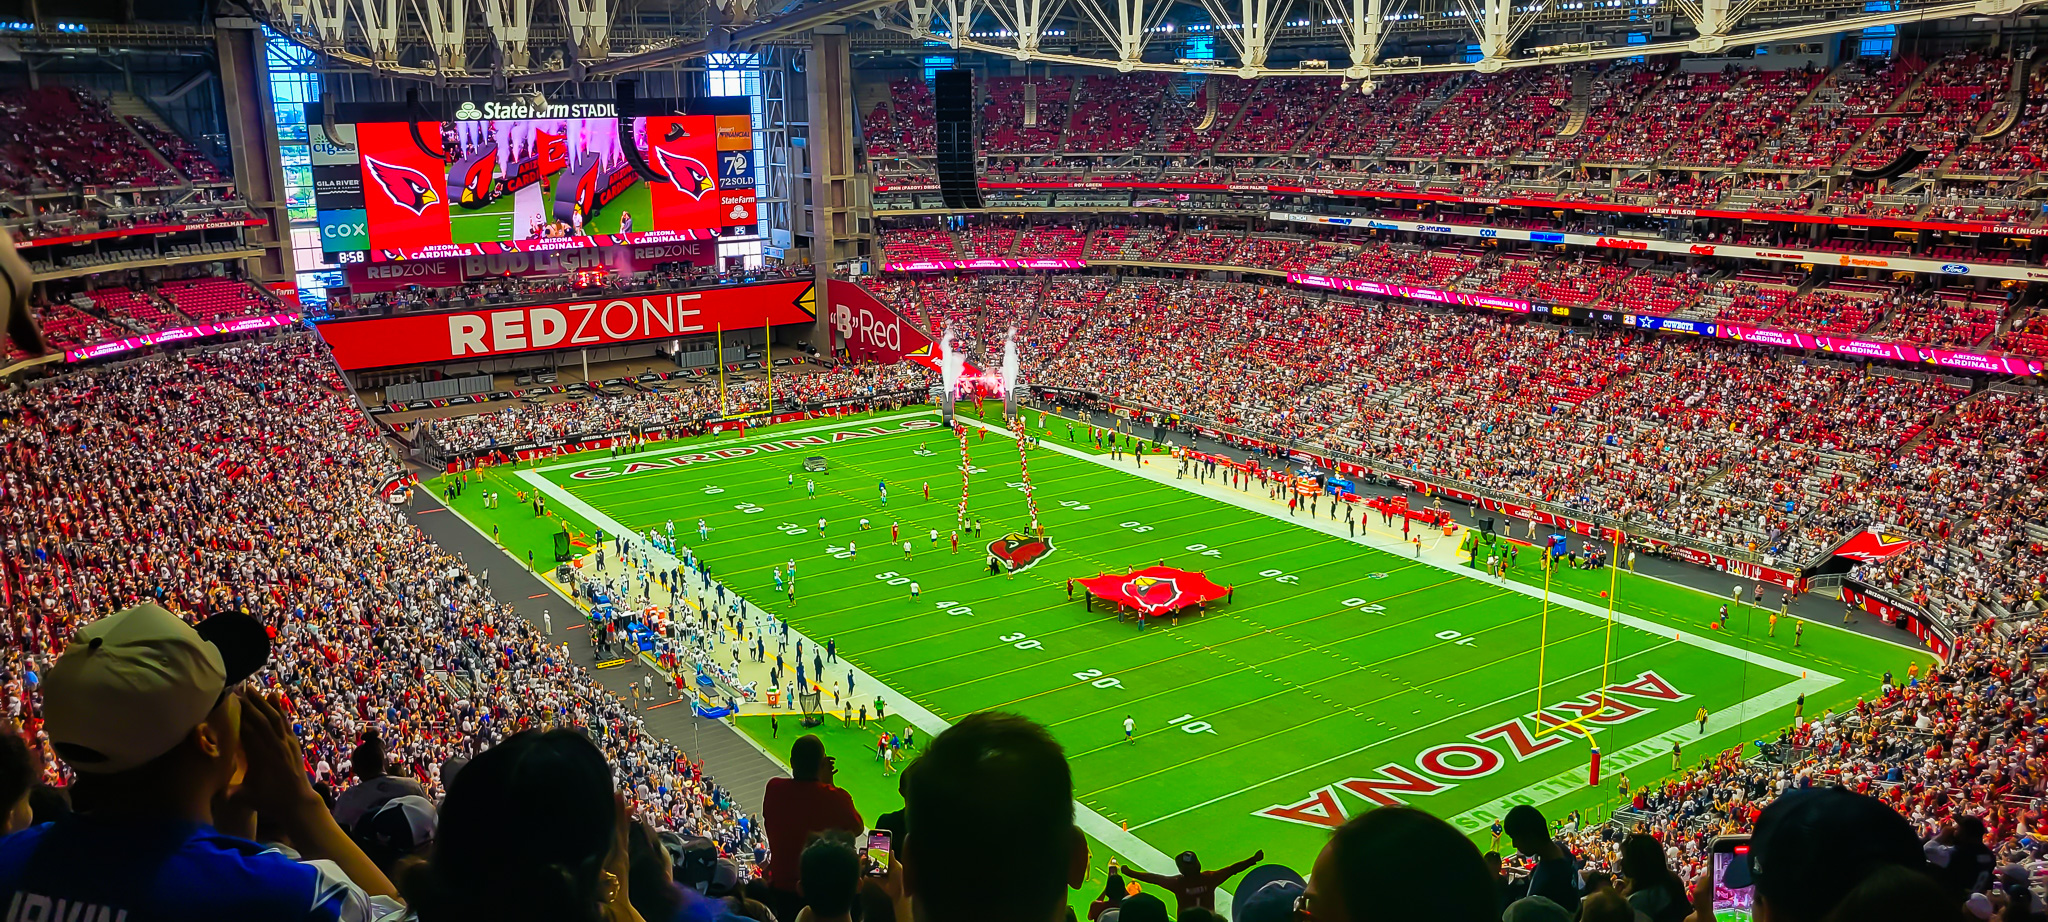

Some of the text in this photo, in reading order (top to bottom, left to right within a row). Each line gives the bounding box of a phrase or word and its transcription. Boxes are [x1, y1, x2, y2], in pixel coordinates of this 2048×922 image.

[519, 160, 538, 174] ARIZ
[507, 169, 539, 192] CARDI
[720, 177, 754, 188] 72SOLD
[185, 220, 245, 231] JIMMY CONZELMAN
[324, 223, 366, 239] COX
[634, 234, 686, 244] CARDINALS
[1480, 229, 1497, 237] COX
[528, 242, 584, 252] CARDINALS
[339, 251, 364, 263] 8:58
[411, 249, 472, 259] CARDINALS
[466, 253, 530, 277] BUD
[1945, 264, 1964, 273] Ford
[1480, 298, 1513, 308] CARDINALS
[1624, 316, 1636, 324] 25
[1663, 320, 1694, 331] COWBOYS
[1707, 326, 1714, 334] 0
[230, 321, 270, 331] CARDINALS
[859, 308, 901, 352] Red
[155, 332, 193, 343] CARDINALS
[1745, 334, 1791, 345] CARDINALS
[1755, 330, 1783, 338] ARIZONA
[1839, 345, 1890, 357] CARDINALS
[1850, 342, 1881, 350] ARIZONA
[1941, 358, 1998, 370] CARDINALS
[1953, 354, 1987, 362] ARIZONA
[570, 419, 942, 480] CARDINALS
[1119, 521, 1154, 533] 50
[1185, 543, 1216, 556] 40
[875, 571, 911, 586] 50
[1258, 569, 1294, 584] 30
[936, 601, 966, 616] 40
[1341, 597, 1381, 613] 20
[1865, 589, 1919, 617] ARIZONA CARDINALS
[999, 632, 1041, 650] 30
[1434, 630, 1472, 645] 10
[1072, 668, 1120, 689] 20
[1167, 713, 1212, 735] 10
[1250, 669, 1697, 831] ARIZONA
[1455, 808, 1504, 830] US
